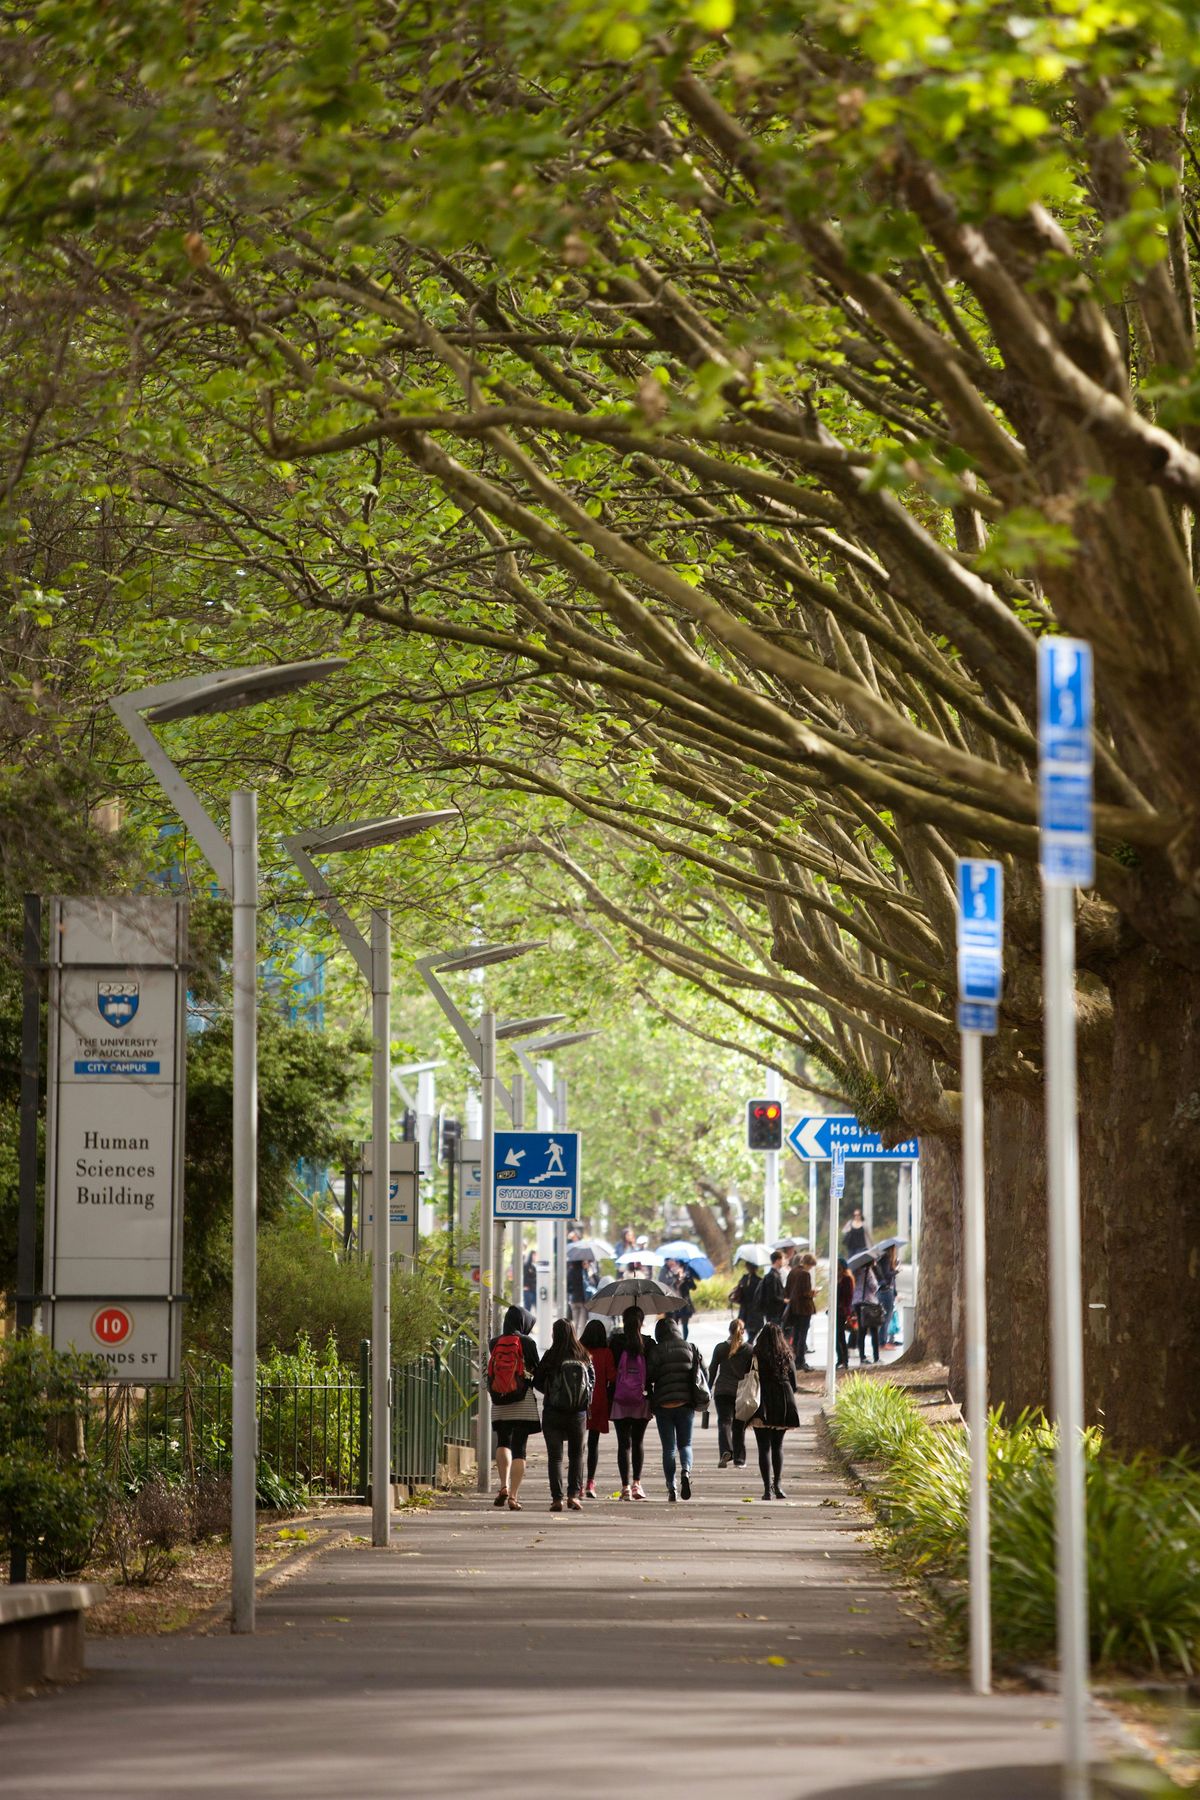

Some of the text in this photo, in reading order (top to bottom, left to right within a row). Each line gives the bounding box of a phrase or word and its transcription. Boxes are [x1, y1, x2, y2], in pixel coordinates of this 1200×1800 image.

[79, 1039, 158, 1047] THE UNIVERSITY
[84, 1049, 154, 1058] OF AUCKLAND
[87, 1063, 147, 1072] CITY CAMPUS
[84, 1131, 149, 1150] Human
[76, 1158, 155, 1178] Sciences
[77, 1186, 155, 1211] Building
[499, 1188, 570, 1200] SYMONDS ST
[500, 1200, 569, 1212] UNDERPASS
[103, 1318, 121, 1334] 10
[141, 1353, 158, 1364] ST
